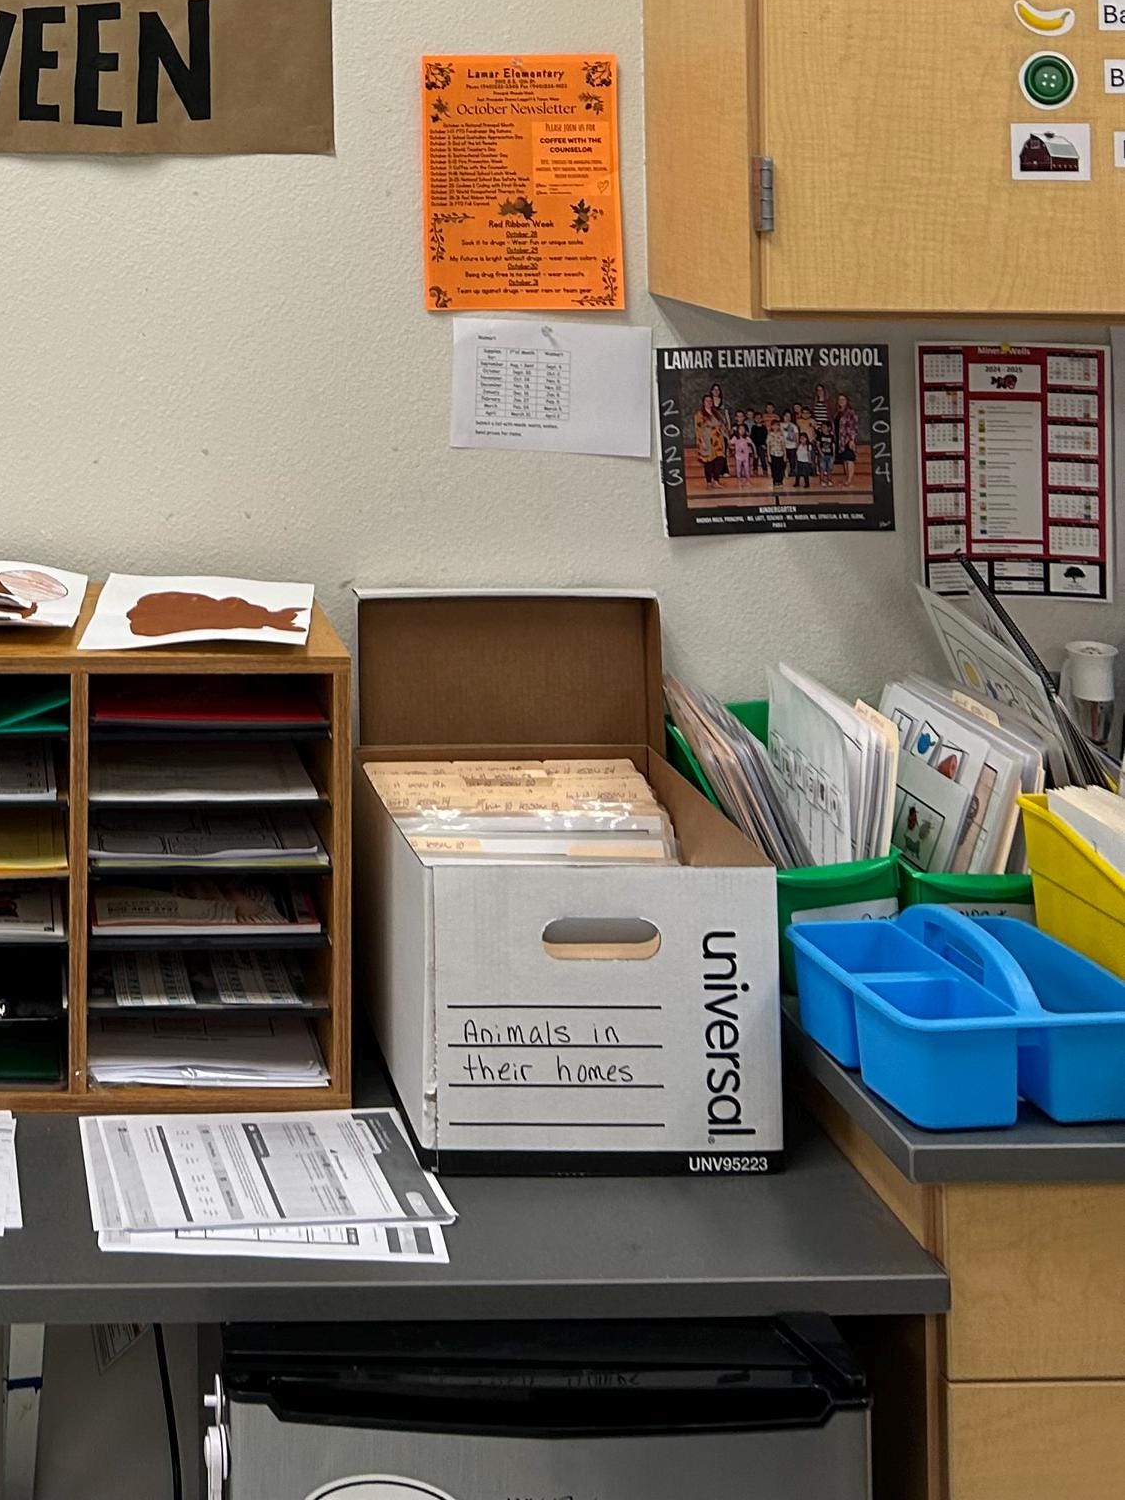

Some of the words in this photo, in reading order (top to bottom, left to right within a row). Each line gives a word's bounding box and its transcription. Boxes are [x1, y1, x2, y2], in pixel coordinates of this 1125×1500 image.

[468, 69, 499, 78] Lamar
[503, 68, 564, 81] Elementary
[456, 102, 507, 115] October
[511, 102, 577, 115] Newsletter
[505, 220, 530, 228] Ribbon
[533, 220, 554, 228] Week
[664, 350, 713, 370] LAMAR
[718, 348, 815, 369] ELEMENTARY
[819, 347, 883, 367] SCHOOL
[464, 1020, 571, 1046] Animals
[594, 1023, 620, 1044] in
[702, 931, 756, 1136] universal
[463, 1054, 533, 1081] their
[558, 1053, 634, 1083] homes
[688, 1156, 769, 1172] UNV95223
